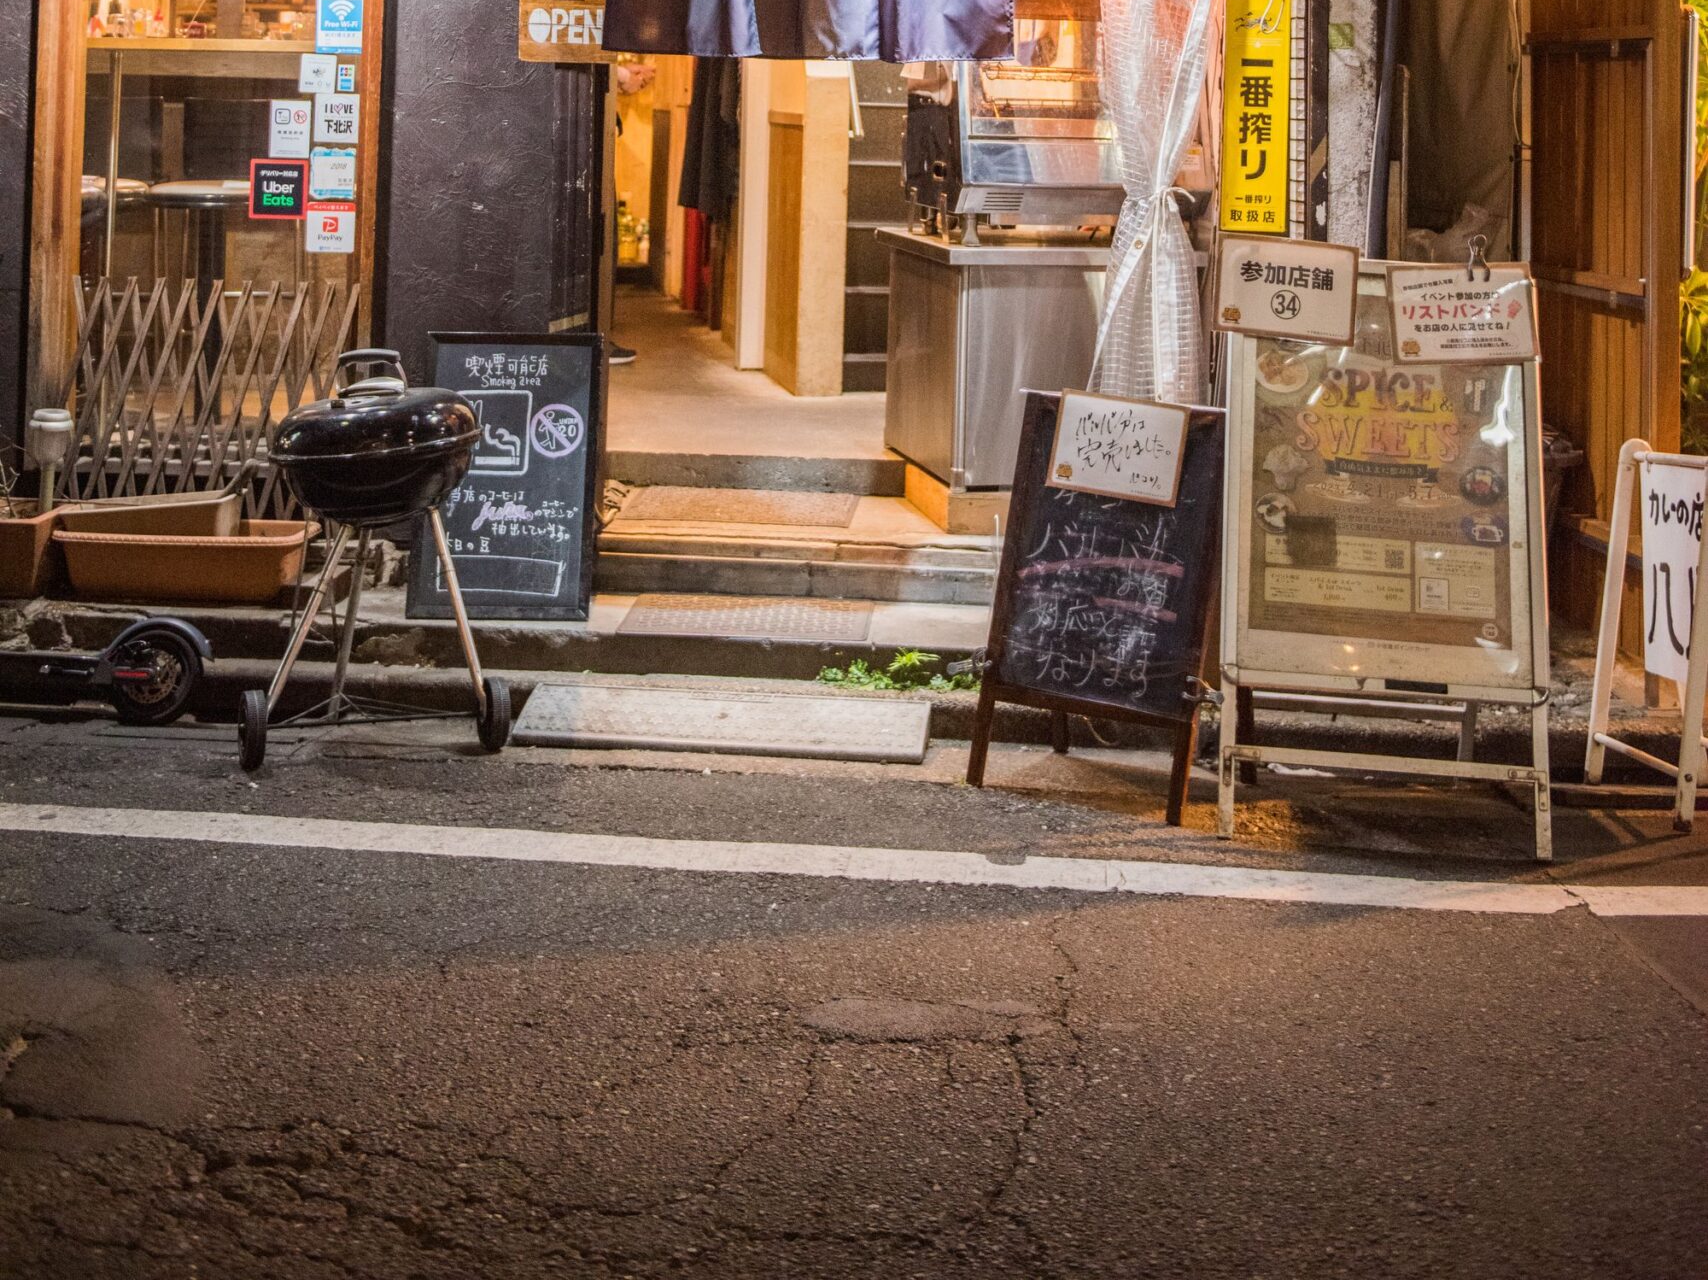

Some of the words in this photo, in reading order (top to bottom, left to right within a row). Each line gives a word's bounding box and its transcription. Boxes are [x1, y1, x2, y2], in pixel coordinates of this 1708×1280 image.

[324, 20, 340, 28] Free
[341, 20, 359, 28] Wi-Fi
[528, 7, 604, 45] OPEN
[324, 119, 353, 134] 下北沢
[1239, 57, 1274, 181] 一番搾り
[263, 180, 295, 194] Uber
[263, 194, 295, 207] Eats
[1230, 209, 1276, 223] 取扱店
[317, 234, 342, 242] PayPay
[1240, 260, 1335, 292] 参加店舗
[465, 352, 549, 377] 喫煙可能店
[481, 374, 517, 390] Smoking
[1321, 368, 1436, 413] SPICE
[558, 424, 577, 438] 20
[1296, 410, 1460, 464] SWEETS
